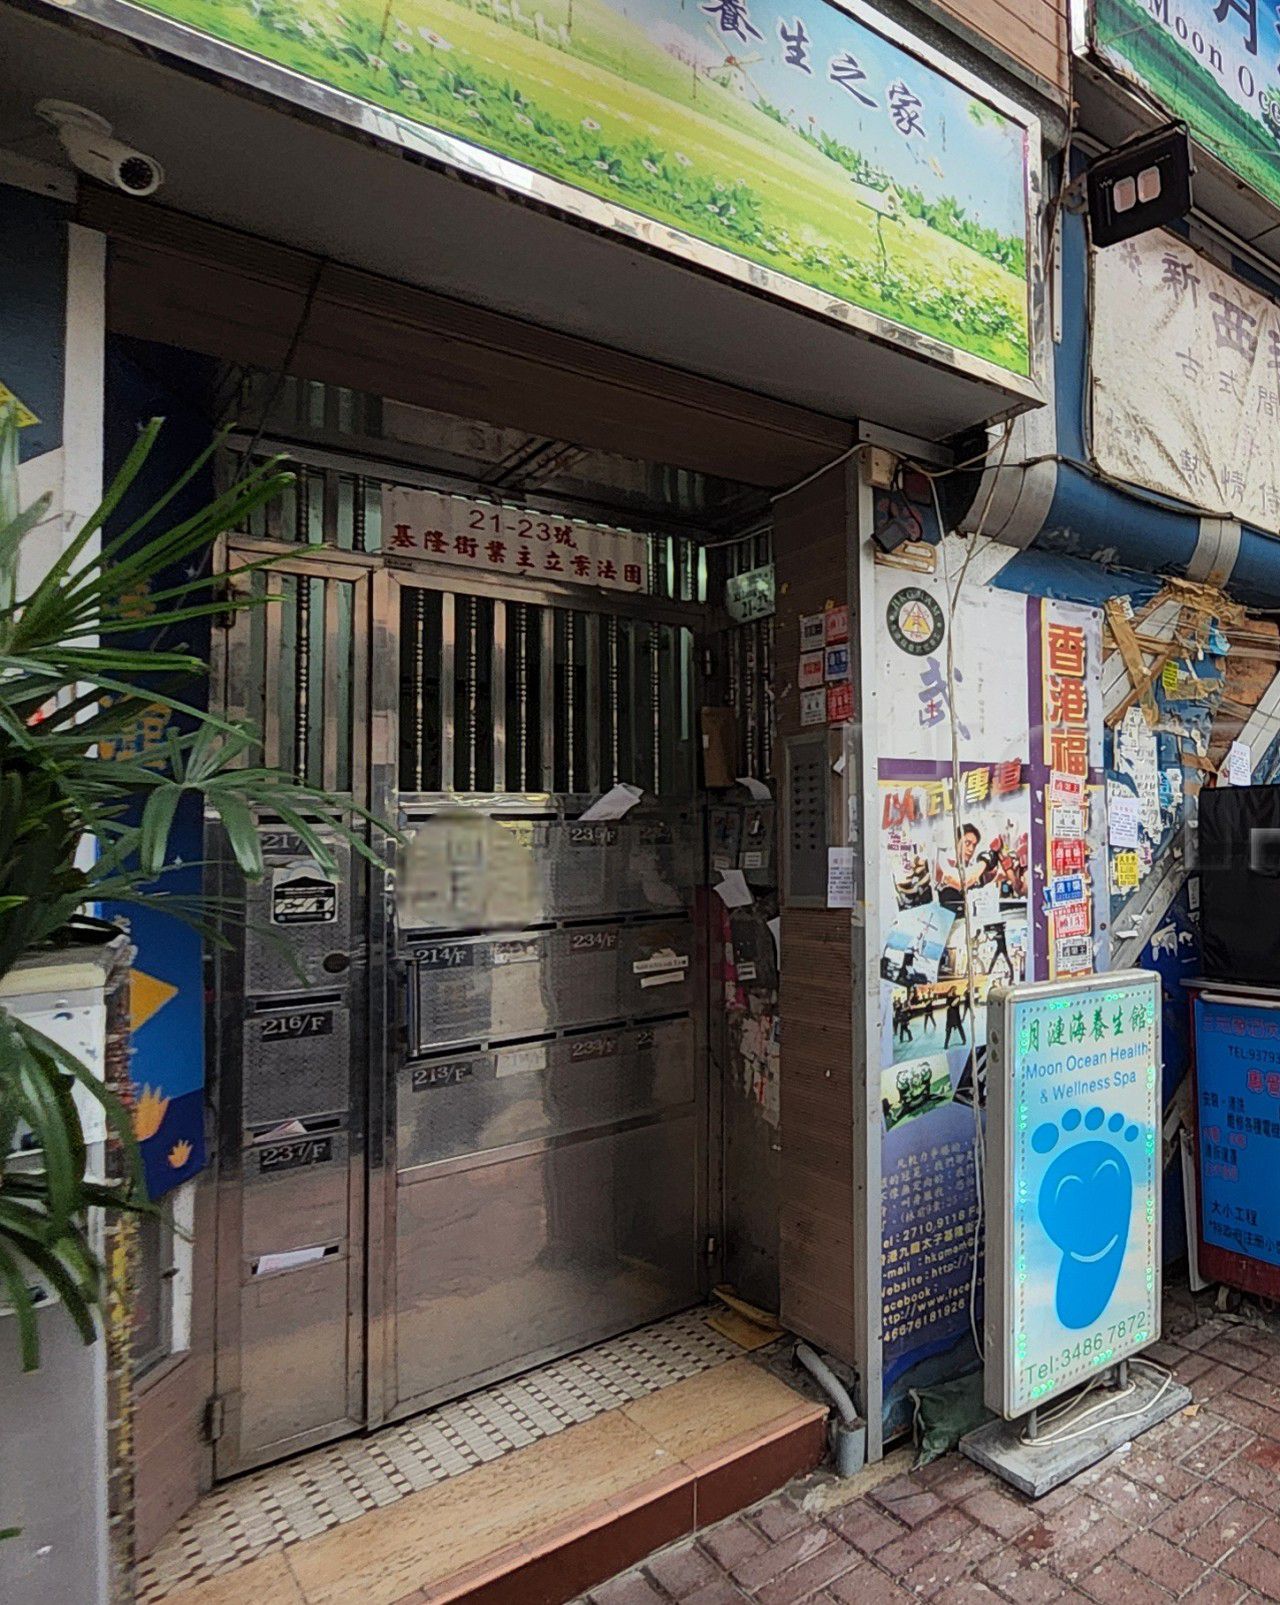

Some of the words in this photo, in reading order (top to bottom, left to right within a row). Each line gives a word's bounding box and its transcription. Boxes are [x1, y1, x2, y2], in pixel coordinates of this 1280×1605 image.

[1148, 0, 1224, 75] Moon
[469, 509, 580, 551] 21-23號
[390, 523, 642, 585] 基隆街業主立案法團
[416, 946, 467, 966] 214/F
[261, 1014, 326, 1036] 216/F
[414, 1065, 466, 1086] 213/F
[1025, 1061, 1063, 1081] Moon
[1065, 1053, 1106, 1074] Ocean
[1110, 1042, 1149, 1063] Health
[1039, 1089, 1050, 1104] &
[1052, 1076, 1110, 1102] Wellness
[1113, 1069, 1137, 1090] Spa
[262, 1141, 326, 1166] 237/F
[1211, 1200, 1258, 1227] 大小工程
[1024, 1334, 1102, 1387] Tel:3486
[1108, 1310, 1147, 1344] 7872
